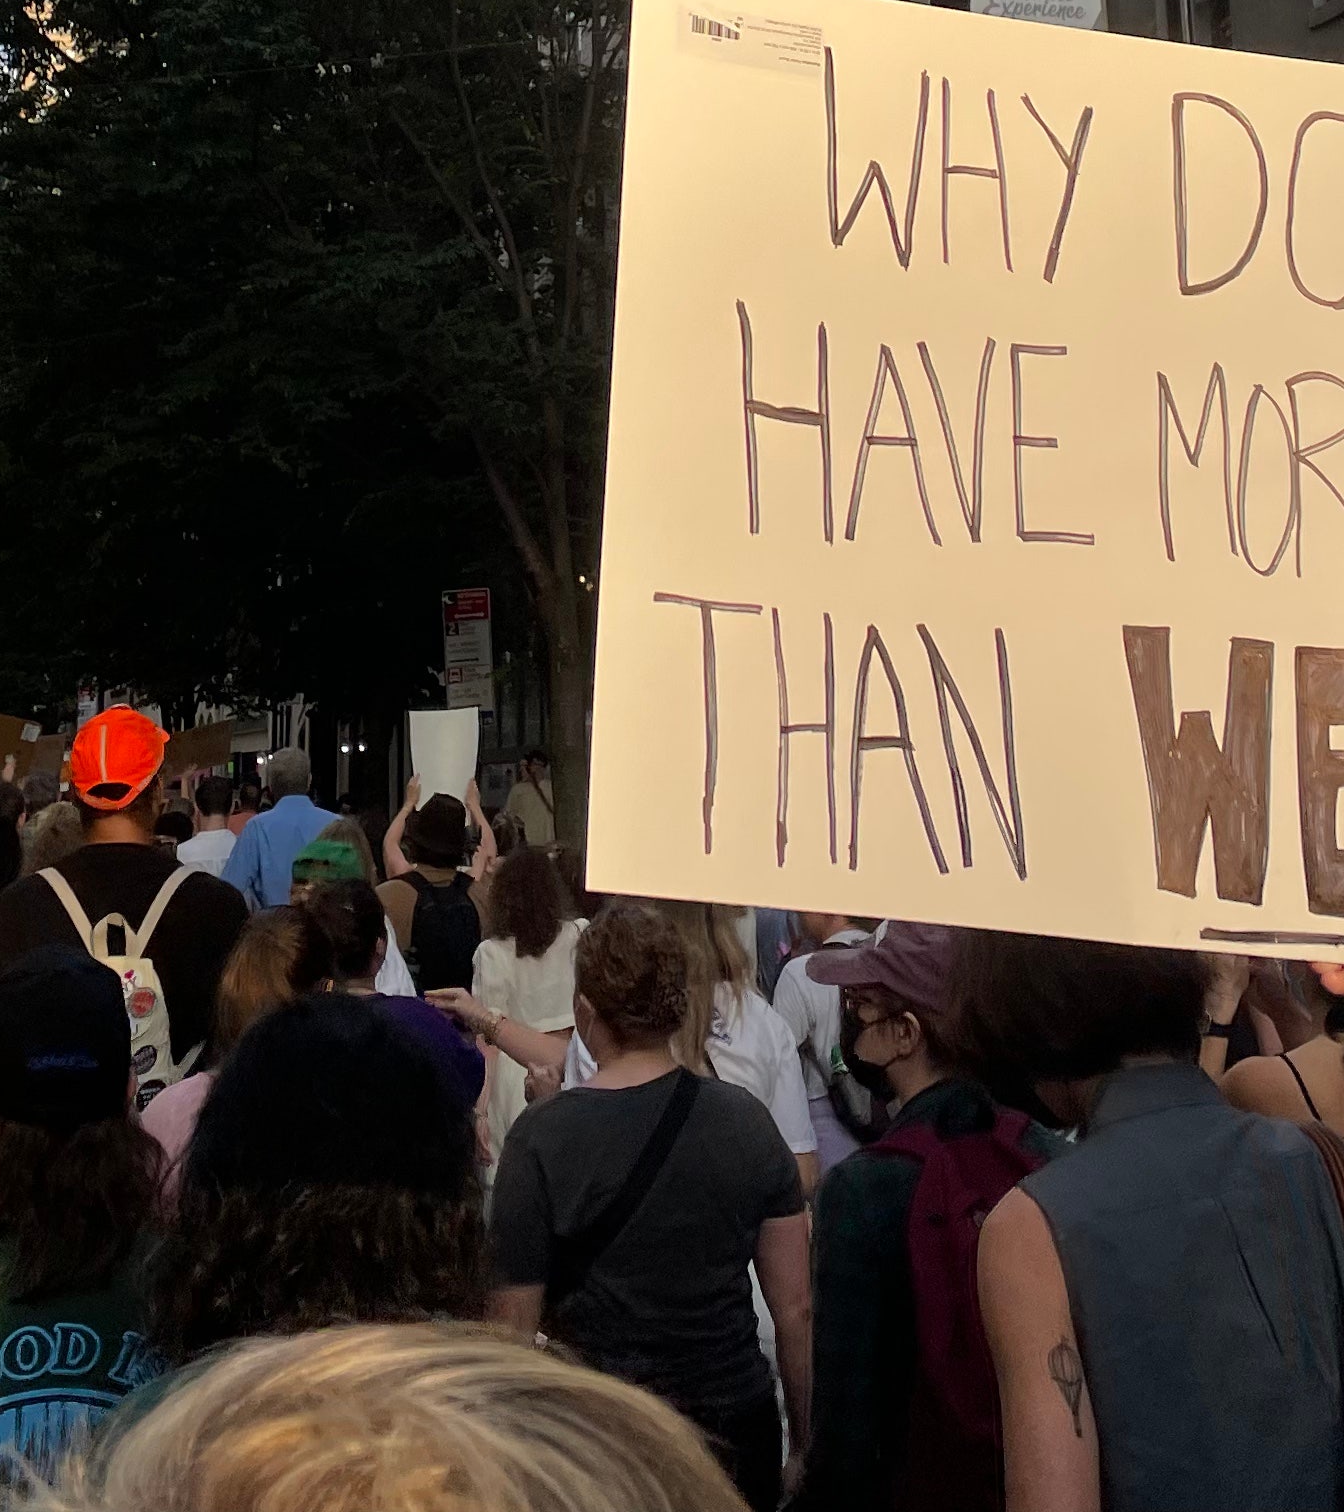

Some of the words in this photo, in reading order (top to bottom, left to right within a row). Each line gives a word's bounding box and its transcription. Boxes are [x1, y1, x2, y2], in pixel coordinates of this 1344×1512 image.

[823, 45, 1094, 284] WHY
[736, 298, 1095, 548] HAVE
[653, 591, 1028, 881] THAN
